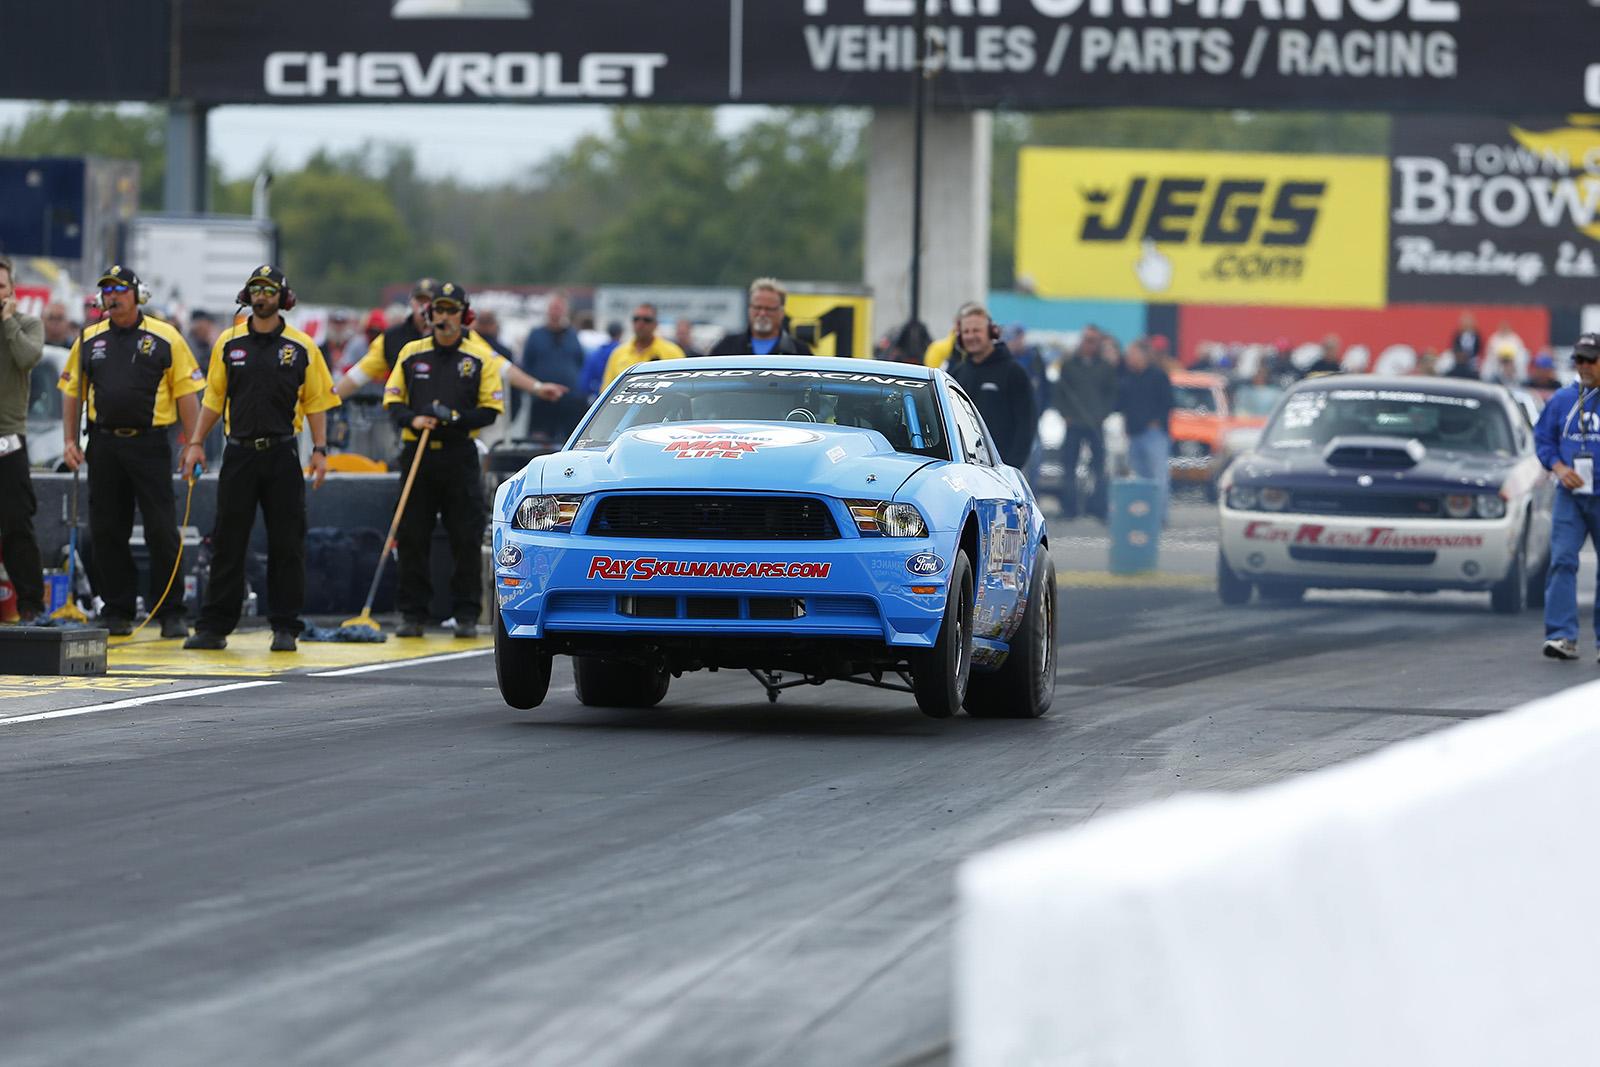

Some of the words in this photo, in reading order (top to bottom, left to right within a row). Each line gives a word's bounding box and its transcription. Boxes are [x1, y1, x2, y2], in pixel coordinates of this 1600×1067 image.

[1080, 26, 1234, 75] PARTS
[1277, 28, 1458, 78] RACING
[264, 52, 668, 98] CHEVROLET
[1453, 143, 1570, 175] TOWN
[1079, 176, 1327, 247] JEGS
[1201, 254, 1304, 282] .com
[626, 370, 752, 384] FORD
[758, 370, 928, 388] RACING
[664, 440, 763, 452] MAX
[676, 450, 742, 459] LIFE
